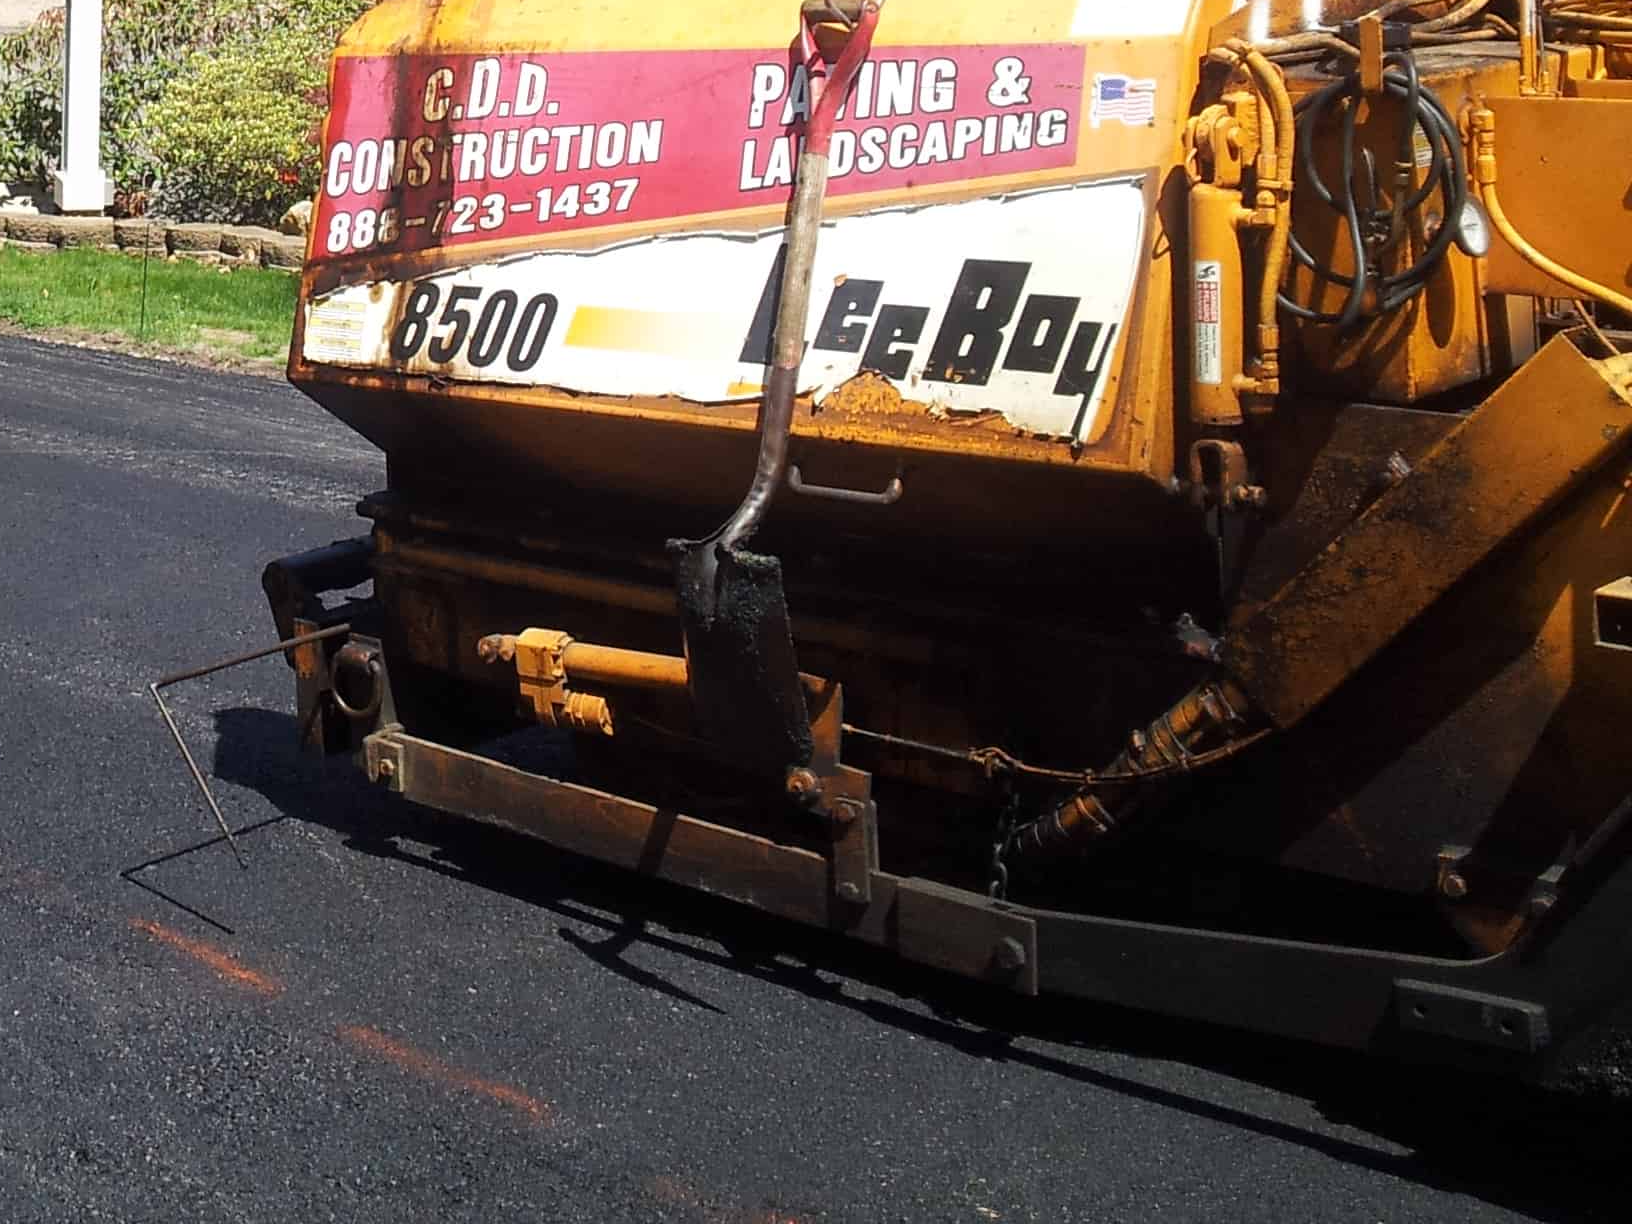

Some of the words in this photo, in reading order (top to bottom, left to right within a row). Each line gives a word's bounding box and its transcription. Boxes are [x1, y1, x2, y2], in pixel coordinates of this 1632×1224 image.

[423, 57, 560, 122] C.D.D.
[748, 58, 957, 128] PAING
[987, 56, 1031, 107] &
[326, 119, 664, 198] CONSTRUCTION
[739, 109, 1068, 191] LADSCAPING
[327, 178, 639, 253] 888-723-1437
[391, 281, 559, 372] 8500
